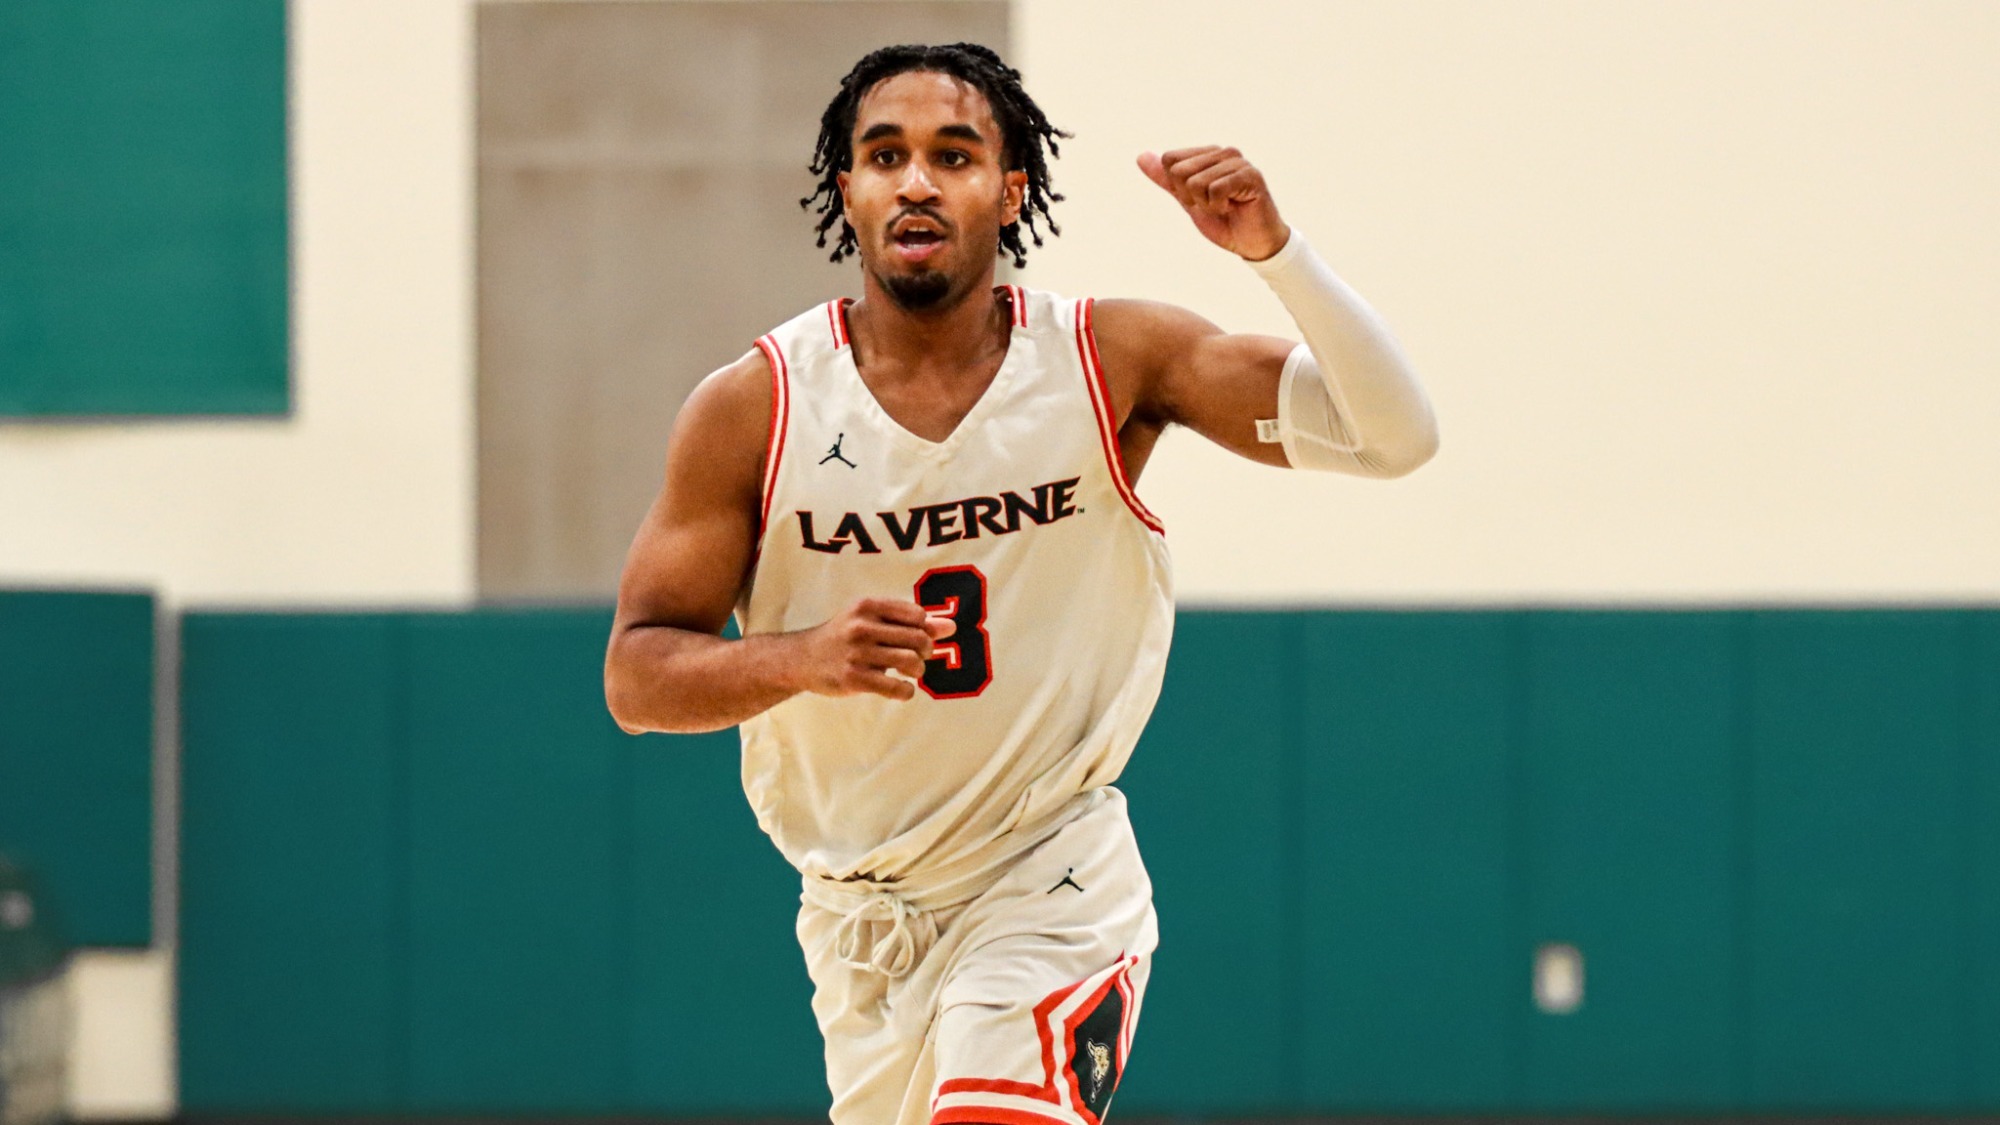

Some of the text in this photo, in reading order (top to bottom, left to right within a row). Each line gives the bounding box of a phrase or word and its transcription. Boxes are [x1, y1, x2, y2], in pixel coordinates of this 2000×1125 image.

[796, 510, 881, 554] LA
[877, 476, 1081, 551] VERNE
[914, 564, 993, 700] 3
